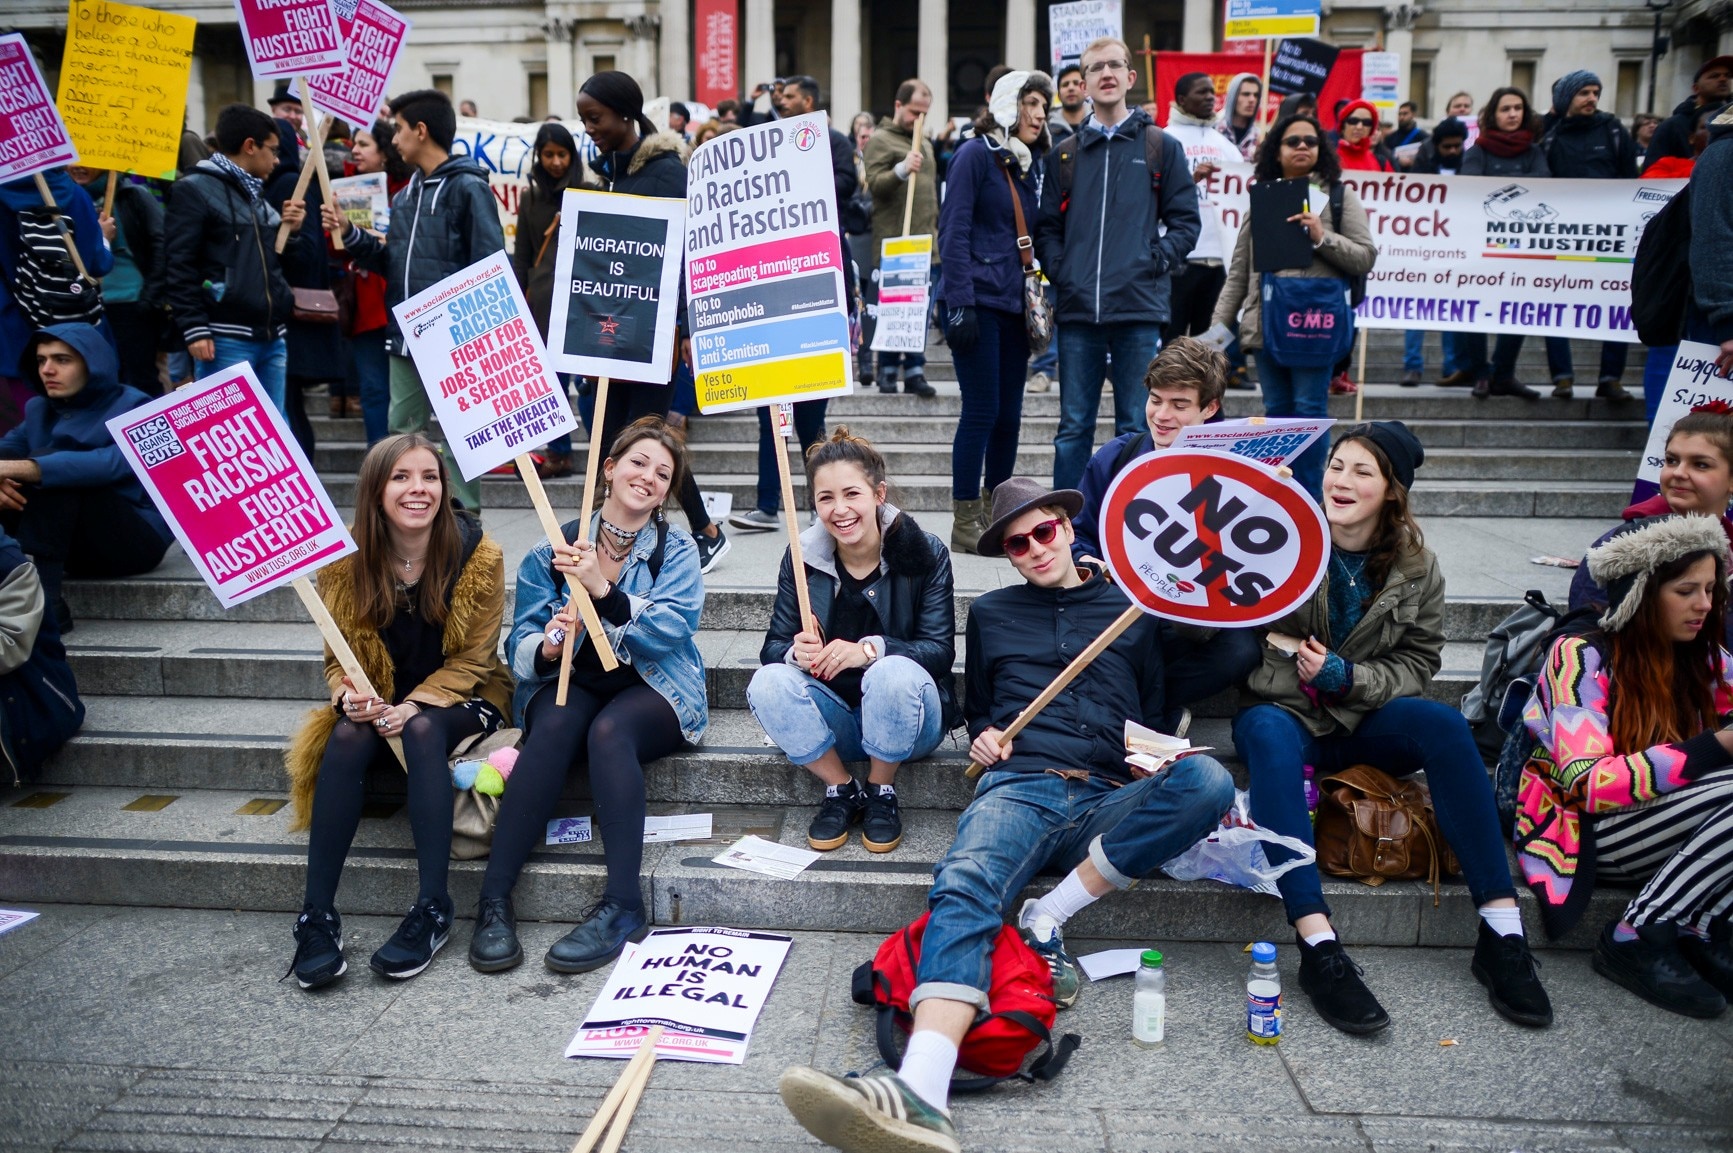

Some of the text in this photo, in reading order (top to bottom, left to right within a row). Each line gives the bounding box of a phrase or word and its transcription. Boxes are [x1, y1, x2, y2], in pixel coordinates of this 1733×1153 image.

[96, 2, 138, 27] those
[143, 16, 175, 36] who
[283, 5, 329, 32] FIGHT
[75, 23, 125, 45] believe
[129, 37, 140, 47] a
[253, 26, 335, 60] AUSTERITY
[350, 18, 398, 56] FIGHT
[274, 53, 325, 69] WWW.TUSC.ORG.UK
[343, 37, 392, 76] ACISM
[0, 61, 31, 90] GHT
[0, 82, 44, 114] CISM
[10, 106, 53, 135] FIGHT
[789, 126, 798, 144] STAND
[808, 121, 821, 138] RACISM
[0, 123, 62, 164] USTERITY
[689, 128, 784, 186] STAND UP
[689, 169, 791, 218] to Racism
[1342, 175, 1447, 204] ntion
[688, 198, 828, 252] and Fascism
[1486, 221, 1628, 237] MOVEMENT
[576, 236, 665, 258] MIGRATION
[1388, 245, 1467, 261] immigrants
[1486, 237, 1521, 248] FOR
[1528, 238, 1625, 253] JUSTICE
[610, 262, 624, 276] IS
[692, 259, 717, 276] No to
[693, 251, 831, 292] scapegoating immigrants
[404, 264, 503, 320] www.socialistparty.org.uk
[572, 280, 658, 302] BEAUTIFUL
[1434, 270, 1452, 284] of
[1457, 271, 1503, 289] proof
[1511, 272, 1526, 287] in
[1533, 274, 1593, 293] asylum
[1601, 280, 1633, 291] cas
[448, 276, 511, 322] SMASH
[695, 296, 721, 313] No to
[791, 299, 835, 310] #MuslimLivesMatter
[418, 313, 443, 329] Socialist
[449, 296, 519, 346] RACISM
[695, 302, 765, 328] islamophobia
[1288, 312, 1335, 329] GMB
[1358, 296, 1480, 323] MOVEMENT
[1500, 301, 1568, 328] FIGHT
[1573, 304, 1602, 330] TO
[450, 318, 527, 370] FIGHT FOR
[699, 334, 726, 350] No to
[701, 343, 770, 365] anti Semitism
[440, 337, 535, 399] JOBS, HOMES
[703, 372, 733, 387] Yes to
[457, 356, 543, 412] & SERVICES
[492, 376, 552, 417] FOR ALL
[705, 385, 748, 402] diversity
[168, 383, 240, 420] TRADE UNIONIST AND
[174, 391, 246, 430] SOCIALIST COALITION
[130, 417, 167, 442] TUSC
[465, 396, 559, 450] TAKE THE WEALTH
[505, 411, 566, 448] OFF THE 1%
[1187, 426, 1319, 439] www.socialistparty.org.uk
[138, 430, 174, 453] AGAINST
[185, 407, 268, 471] FIGHT
[1230, 434, 1312, 452] SMASH
[144, 442, 181, 465] CUTS
[1244, 445, 1301, 460] CISM
[183, 438, 292, 513] RACISM
[238, 472, 312, 527] FIGHT
[1177, 475, 1289, 555] NO
[205, 498, 328, 581] AUSTERITY
[1124, 498, 1275, 607] CUTS
[245, 540, 320, 583] WWW.TUSC.ORG.UK
[723, 930, 750, 938] REMAIN
[684, 944, 733, 958] NO
[641, 956, 762, 977] HUMAN
[676, 970, 707, 984] IS
[613, 984, 748, 1009] ILLEGAL
[621, 1018, 705, 1034] righttoremain.org.uk
[614, 1036, 709, 1047] WWW.SC.ORG.UK
